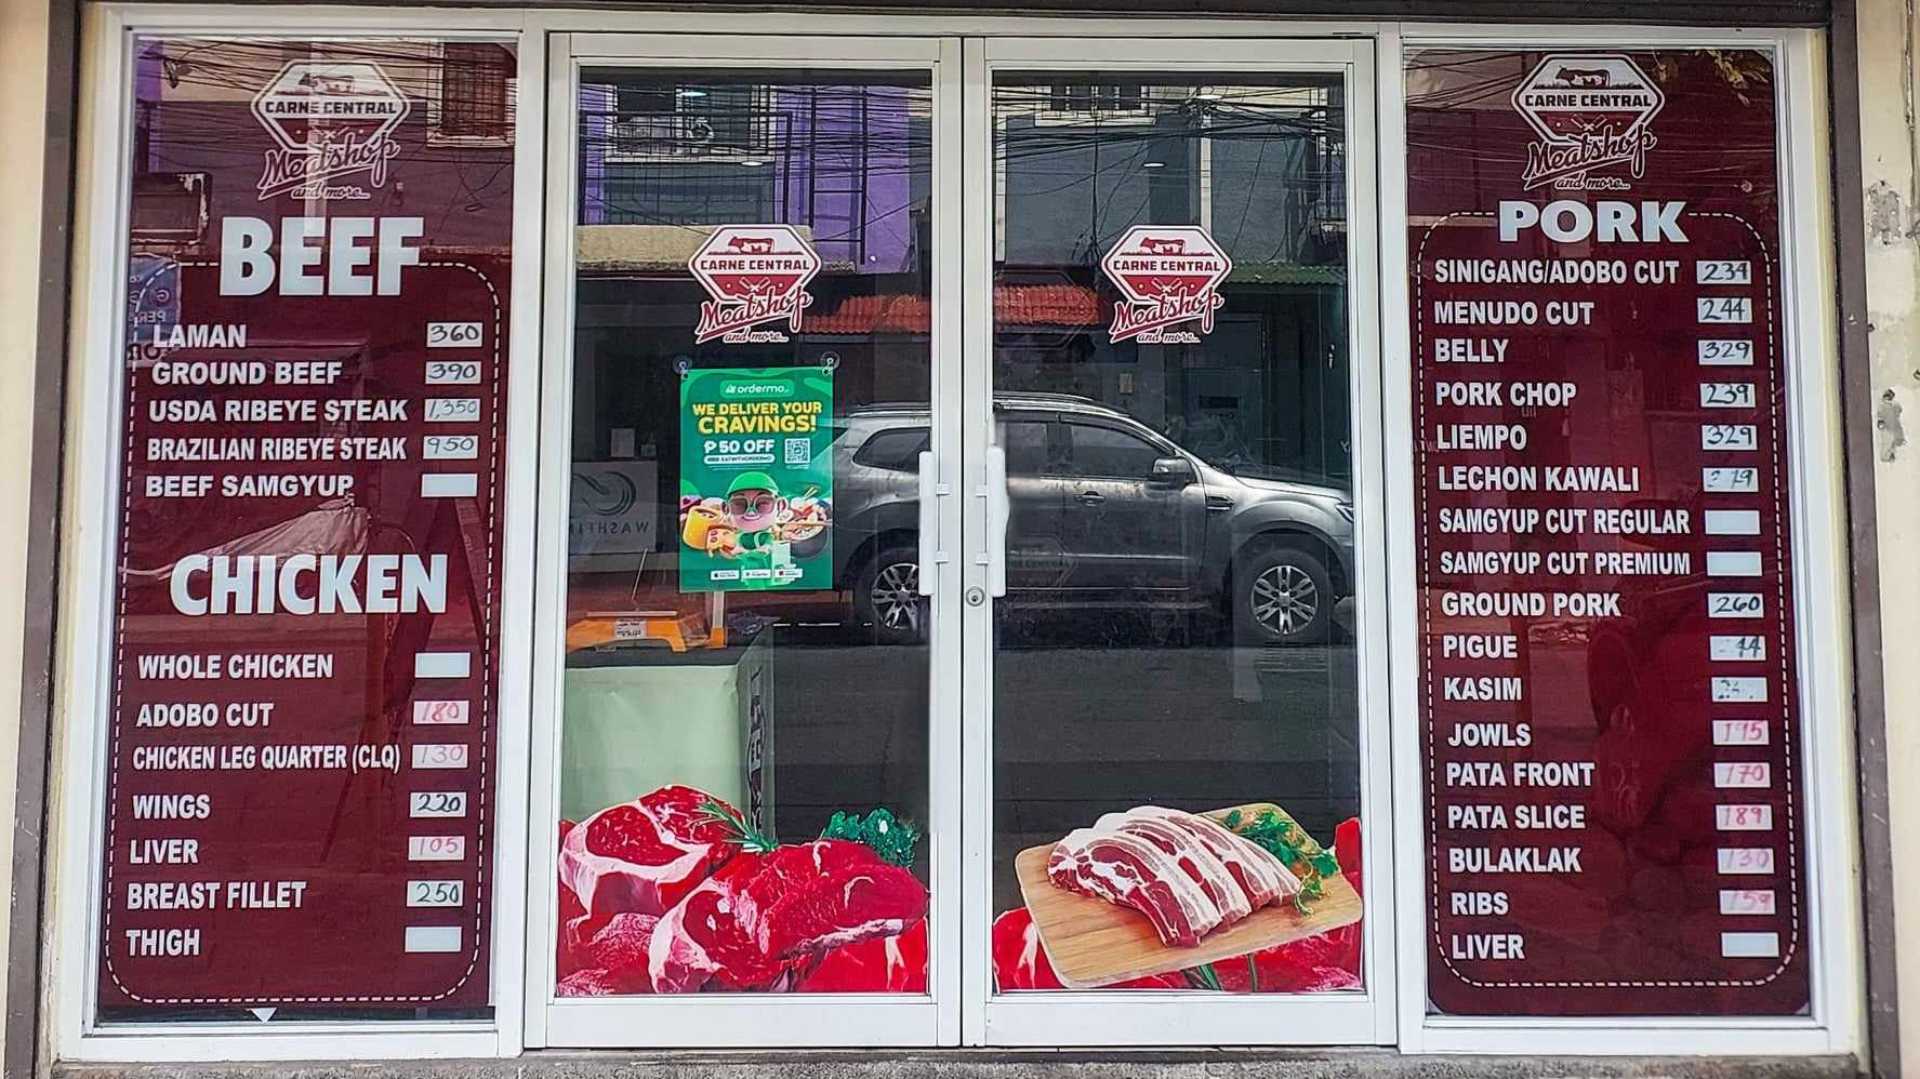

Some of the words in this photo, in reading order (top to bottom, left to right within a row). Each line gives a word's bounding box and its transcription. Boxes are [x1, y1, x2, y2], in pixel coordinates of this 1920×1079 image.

[265, 101, 320, 114] CARNE
[323, 101, 397, 114] CENTRAL
[1524, 94, 1577, 107] CARNE
[1580, 94, 1652, 107] CENTRAL
[257, 132, 401, 189] Meatshop
[1522, 123, 1657, 179] Meatshop
[292, 182, 321, 199] and
[1555, 173, 1585, 190] and
[1499, 200, 1690, 243] PORK
[219, 216, 424, 297] BEEF
[700, 259, 745, 271] CARNE
[748, 259, 810, 271] CENTRAL
[1113, 260, 1157, 272] CARNE
[1161, 260, 1221, 272] CENTRAL
[1435, 259, 1627, 285] SINIGANG/ADOBO
[1634, 260, 1680, 284] CUT
[696, 285, 812, 333] Meatshop
[1109, 286, 1225, 334] Meatshop
[1434, 301, 1538, 325] MENUDO
[1545, 302, 1595, 325] CUT
[1702, 299, 1747, 322] 244
[152, 324, 247, 348] LAMAN
[430, 324, 479, 342] 360
[724, 328, 747, 344] and
[1137, 329, 1161, 344] and
[1435, 338, 1509, 363] BELLY
[1703, 341, 1751, 360] 329
[152, 361, 267, 385] GROUND
[274, 361, 342, 385] BEEF
[427, 363, 477, 379] 390
[1436, 382, 1503, 407] PORK
[1509, 382, 1577, 407] CHOP
[1705, 384, 1749, 405] 239
[149, 399, 218, 422] USDA
[224, 399, 318, 422] RIBEYE
[324, 399, 408, 422] STEAK
[427, 399, 477, 420] 1,350
[692, 403, 715, 416] WE
[718, 402, 780, 416] DELIVER
[783, 401, 823, 415] YOUR
[698, 415, 818, 434] CRAVINGS!
[1706, 426, 1753, 446] 329
[147, 438, 255, 461] BRAZILIAN
[260, 438, 335, 461] RIBEYE
[339, 437, 407, 461] STEAK
[426, 436, 475, 453] 950
[718, 440, 741, 454] 50
[743, 439, 776, 454] OFF
[1437, 424, 1528, 450] LIEMPO
[145, 475, 213, 497] BEEF
[221, 474, 354, 497] SAMGYUP
[1438, 466, 1537, 491] LECHON
[1545, 466, 1640, 491] KAWALI
[1439, 508, 1538, 533] SAMGYUP
[1545, 509, 1588, 533] CUT
[1593, 509, 1692, 533] REGULAR
[1440, 551, 1541, 575] SAMGYUP
[1547, 551, 1589, 575] CUT
[1595, 551, 1691, 575] PREMIUM
[169, 553, 449, 616] CHICKEN
[1441, 592, 1547, 617] GROUND
[1553, 592, 1622, 617] PORK
[1714, 596, 1761, 614] 260
[1443, 635, 1518, 659] PIGUE
[138, 653, 222, 679] WHOLE
[228, 653, 334, 679] CHICKEN
[1443, 677, 1523, 701] KASIM
[136, 703, 219, 728] ADOBO
[225, 703, 275, 728] CUT
[421, 702, 460, 723] 180
[1448, 723, 1533, 747] JOWLS
[132, 746, 215, 770] CHICKEN
[220, 746, 257, 770] LEG
[261, 746, 348, 770] QUARTER
[352, 745, 402, 774] (CLQ)
[420, 745, 466, 764] 130
[1446, 762, 1509, 787] PATA
[1513, 762, 1596, 787] FRONT
[1726, 764, 1765, 785] 170
[132, 794, 211, 820] WINGS
[417, 793, 461, 812] 220
[1447, 804, 1509, 830] PATA
[1514, 804, 1586, 830] SLICE
[1723, 806, 1763, 826] 189
[129, 838, 199, 865] LIVER
[419, 837, 459, 856] 105
[1449, 847, 1583, 873] BULAKLAK
[1726, 849, 1770, 869] 130
[127, 882, 220, 911] BREAST
[226, 880, 307, 909] FILLET
[415, 882, 460, 904] 250
[1451, 891, 1510, 916] RIBS
[125, 928, 201, 957] THIGH
[1451, 933, 1526, 960] LIVER
